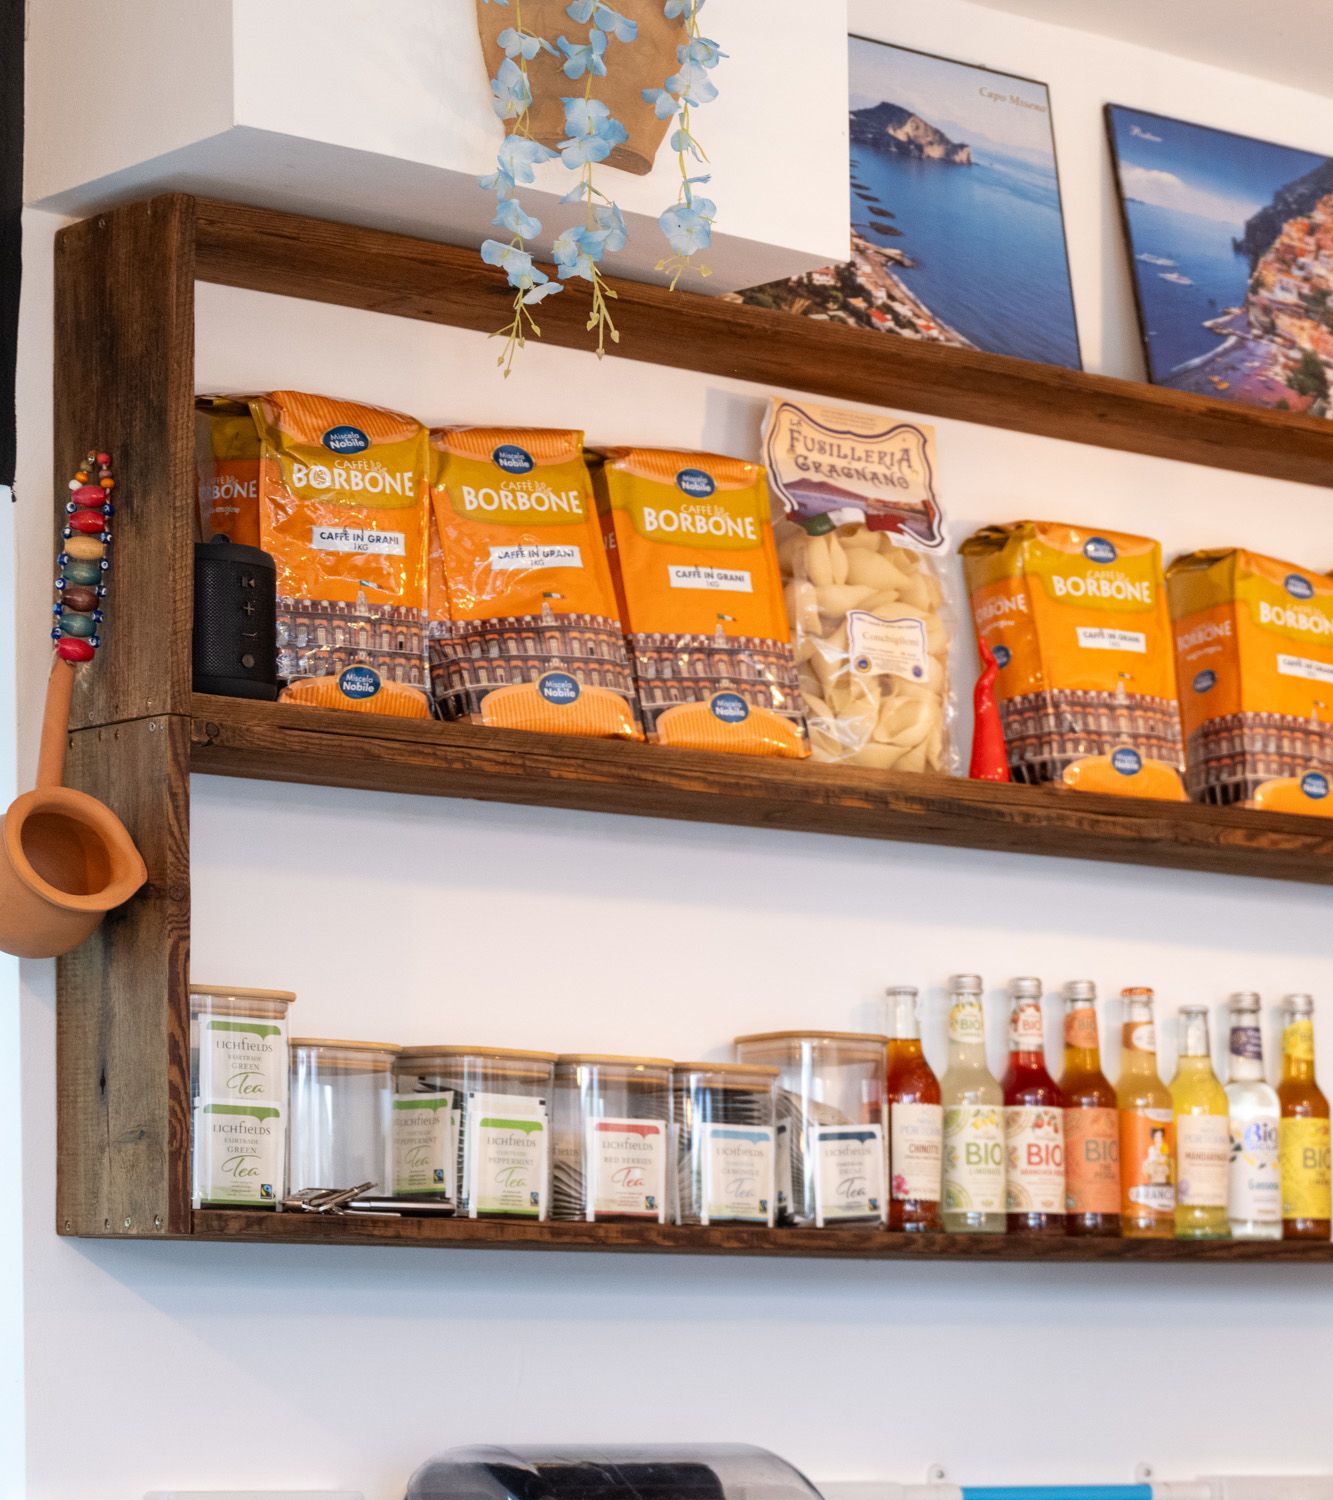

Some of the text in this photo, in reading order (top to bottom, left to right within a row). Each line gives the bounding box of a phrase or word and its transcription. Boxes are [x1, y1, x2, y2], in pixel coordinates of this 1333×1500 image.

[329, 440, 366, 449] Nobile
[330, 431, 360, 444] Miscela
[788, 429, 914, 469] FUSILLERIA
[499, 459, 530, 468] Nobile
[795, 454, 910, 490] GRAGNANO
[292, 463, 415, 497] BORBONE
[462, 485, 583, 513] BORBONE
[643, 507, 757, 540] BORBONE
[352, 531, 365, 541] IN
[367, 535, 399, 545] GRANI
[716, 572, 745, 582] GRANI
[1052, 575, 1153, 603] BORBONE
[342, 681, 375, 693] Nobile
[344, 673, 374, 684] Miscela
[543, 686, 576, 698] Nobile
[715, 706, 746, 717] Nobile
[226, 1071, 266, 1094] Tea
[221, 1154, 261, 1178] Tea
[611, 1166, 648, 1187] Tea
[835, 1176, 868, 1199] Tea
